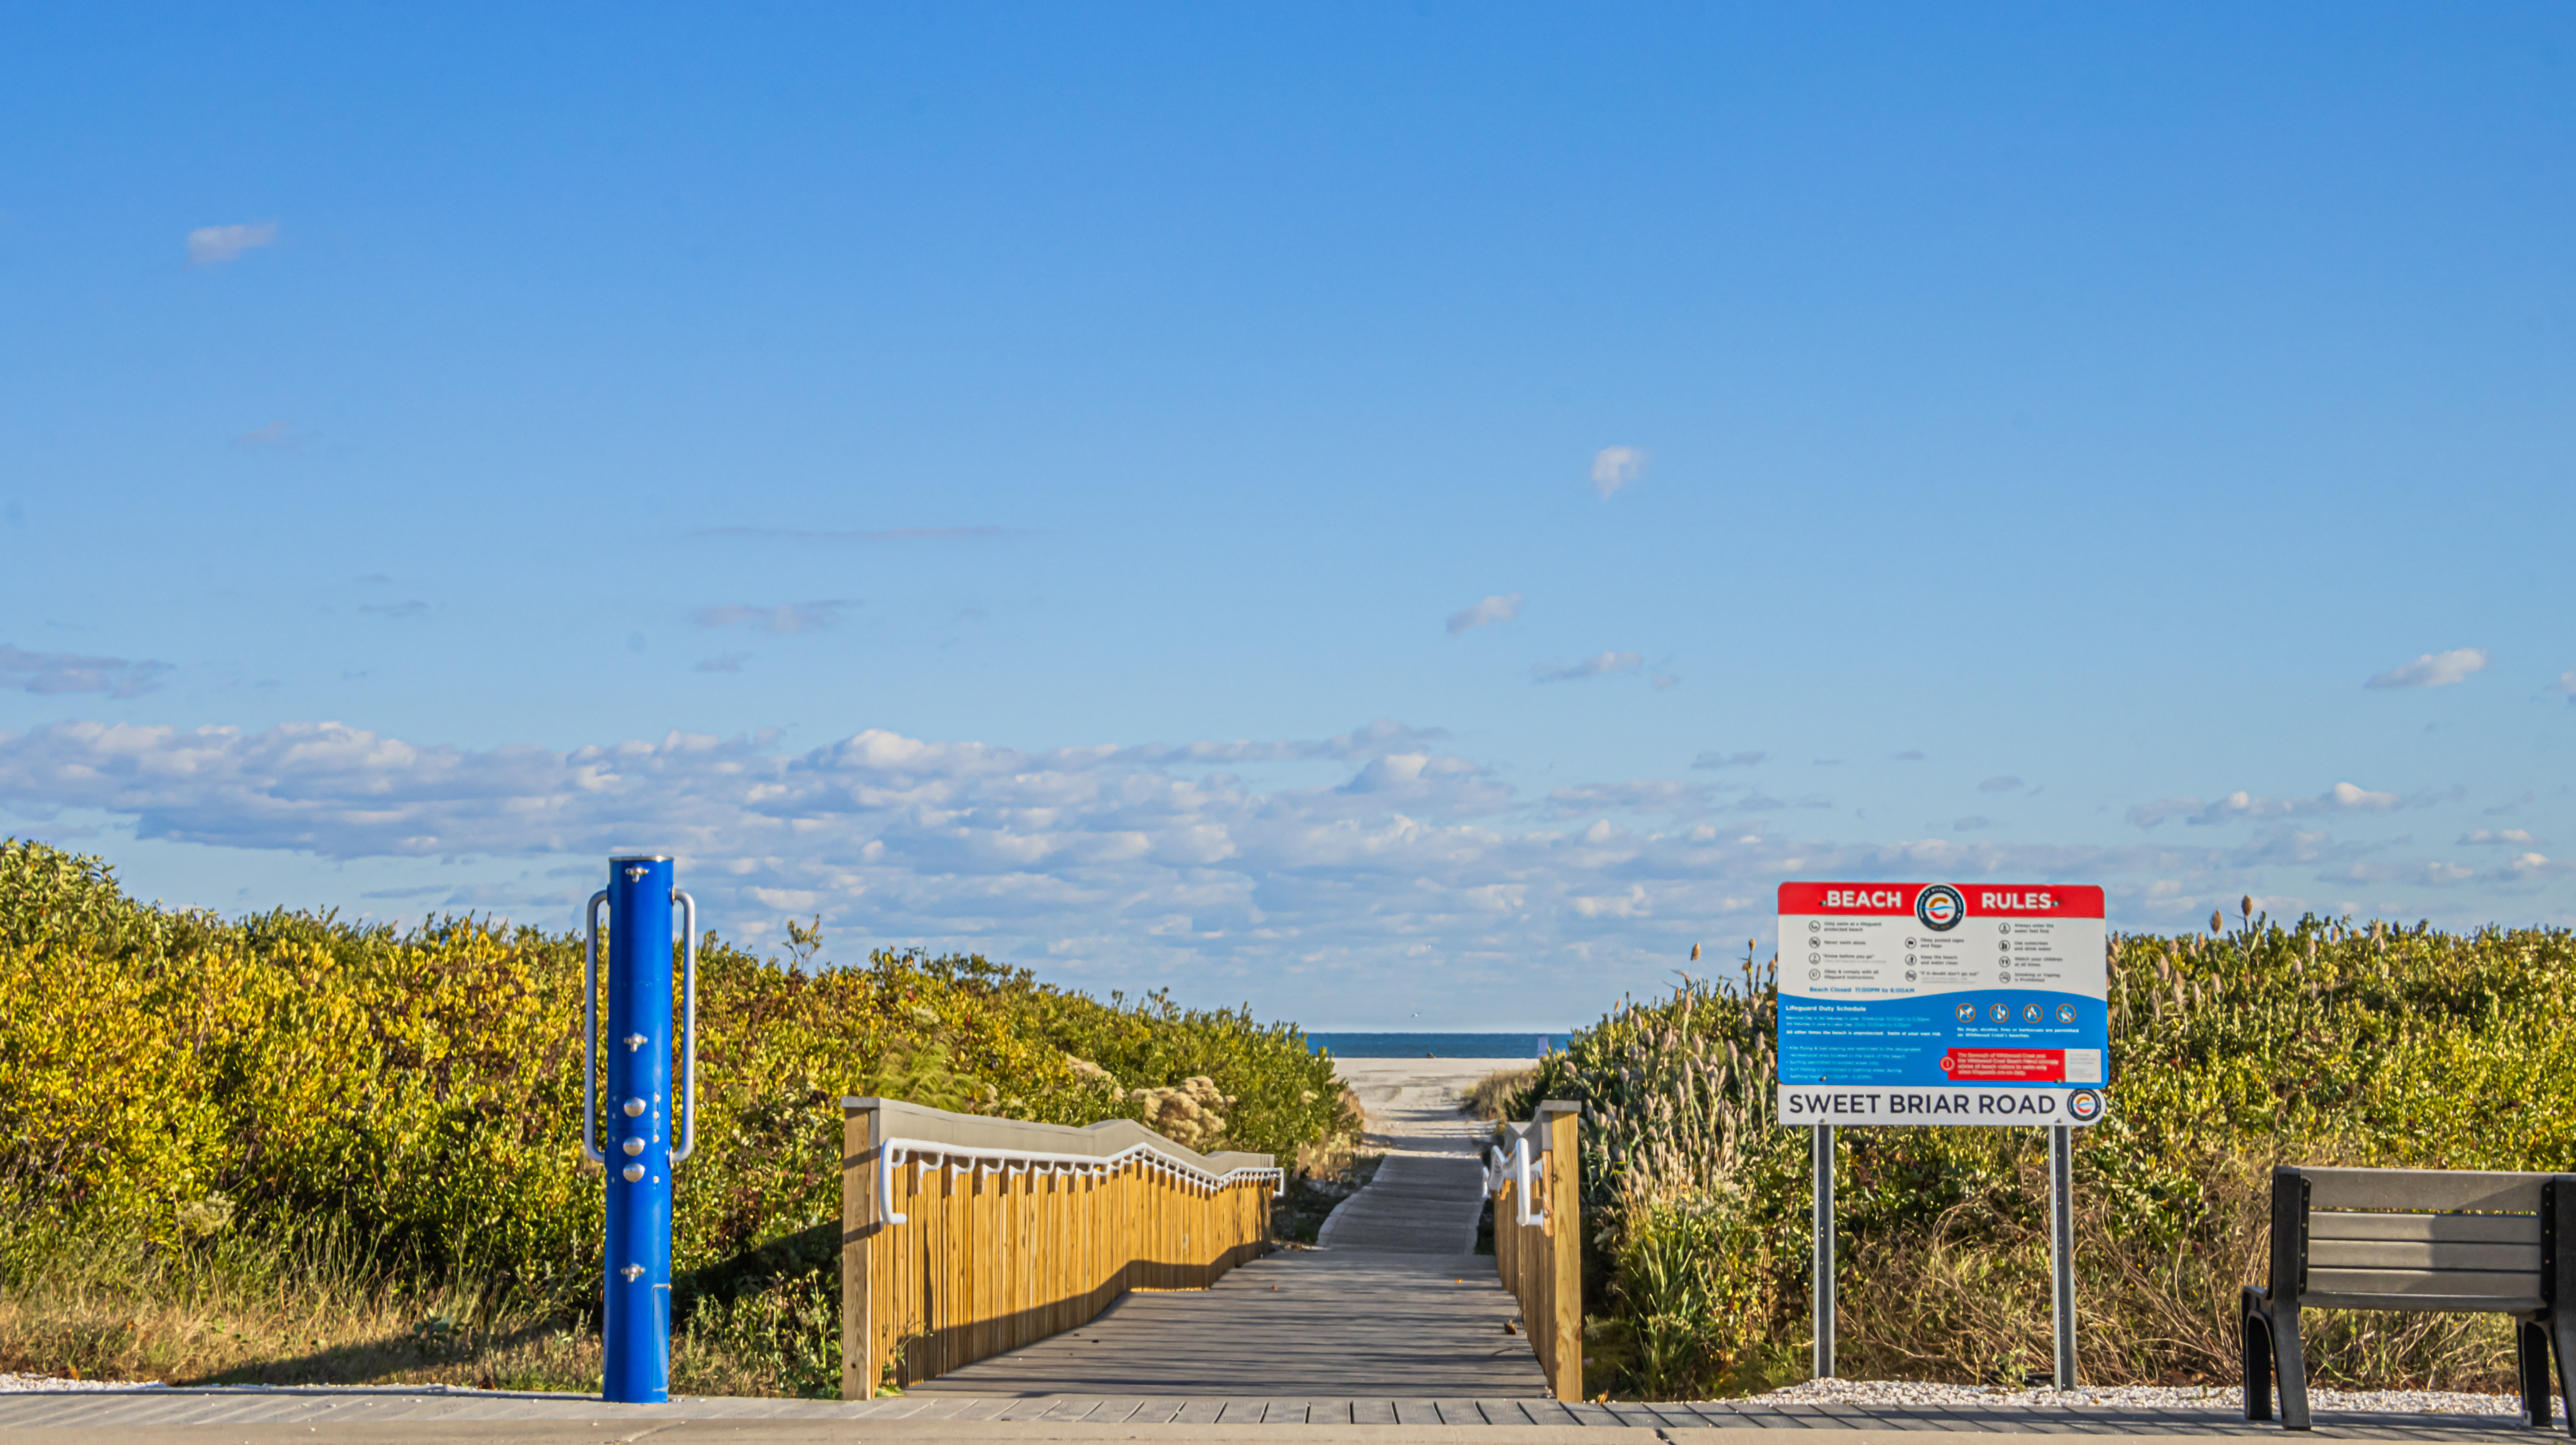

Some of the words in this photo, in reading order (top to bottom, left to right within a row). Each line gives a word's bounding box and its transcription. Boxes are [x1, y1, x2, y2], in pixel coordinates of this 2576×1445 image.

[1828, 891, 1901, 907] BEACH
[1983, 892, 2051, 909] RULES
[1790, 1095, 1880, 1113] SWEET
[1891, 1095, 1969, 1114] BRIAR
[1980, 1095, 2055, 1114] ROAD
